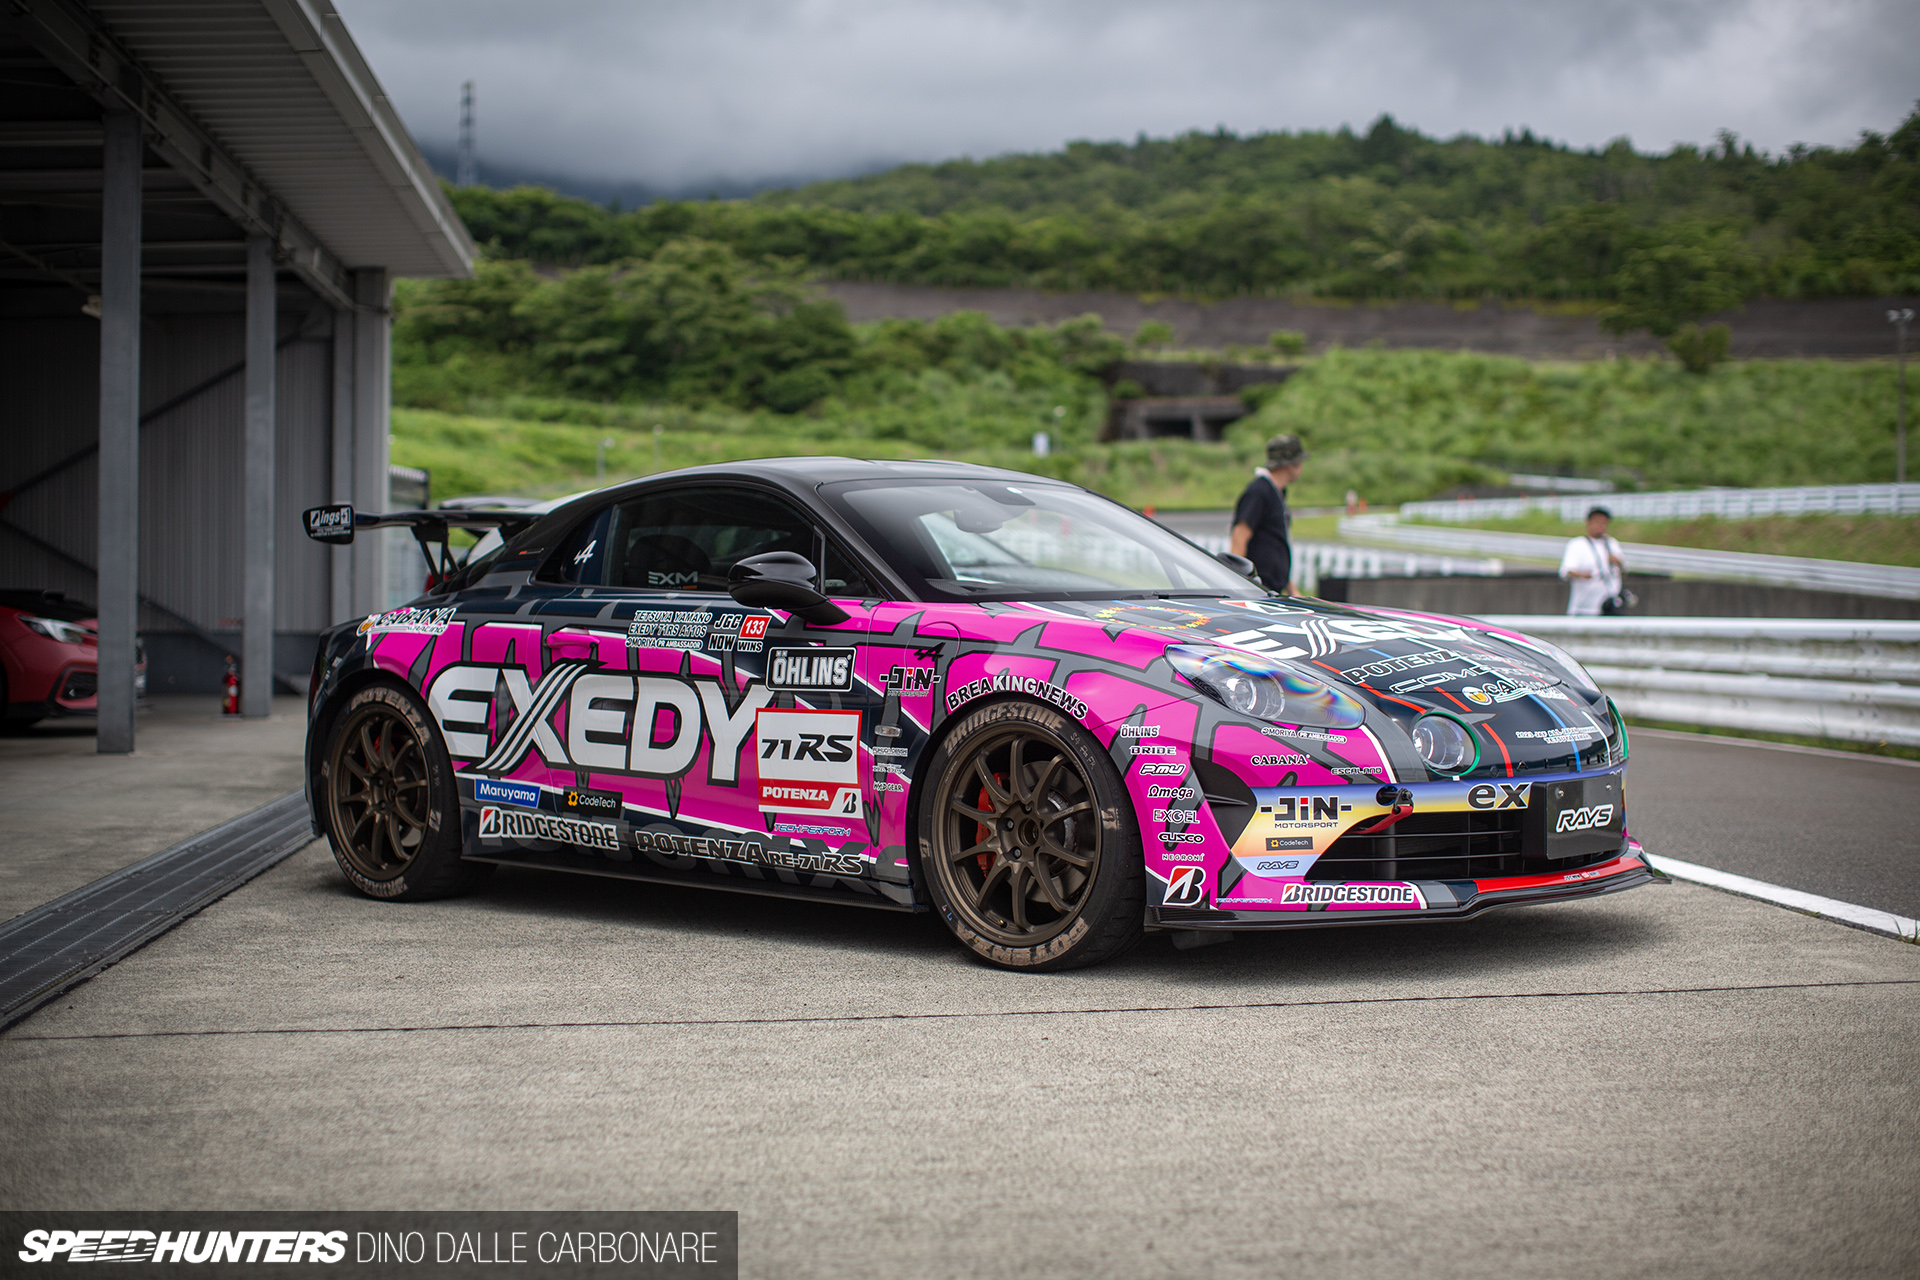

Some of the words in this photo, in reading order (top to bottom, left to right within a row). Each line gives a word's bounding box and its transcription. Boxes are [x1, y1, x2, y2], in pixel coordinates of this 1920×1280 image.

[648, 571, 698, 585] EXM
[634, 610, 674, 622] TETSUYA
[714, 614, 742, 629] JGC
[745, 620, 764, 634] 133
[628, 623, 658, 635] EXEDY
[708, 634, 737, 650] NOW
[737, 640, 763, 652] WINS
[772, 650, 849, 685] ÖHLINS
[428, 663, 775, 781] EXEDY
[761, 733, 854, 762] 71RS
[1130, 746, 1176, 755] BRIDE
[1251, 755, 1308, 766] CABANA
[480, 783, 536, 801] Maruyama
[762, 786, 829, 801] POTENZA
[579, 794, 616, 808] CodeTech
[1556, 804, 1614, 833] RAYS
[479, 806, 620, 851] BRIDGESTONE
[1158, 832, 1204, 843] CUSCO
[636, 831, 767, 865] POTENZA
[1162, 853, 1204, 861] NEGRONI
[1257, 860, 1299, 870] RAYS
[1281, 883, 1414, 904] BRIDGESTONE
